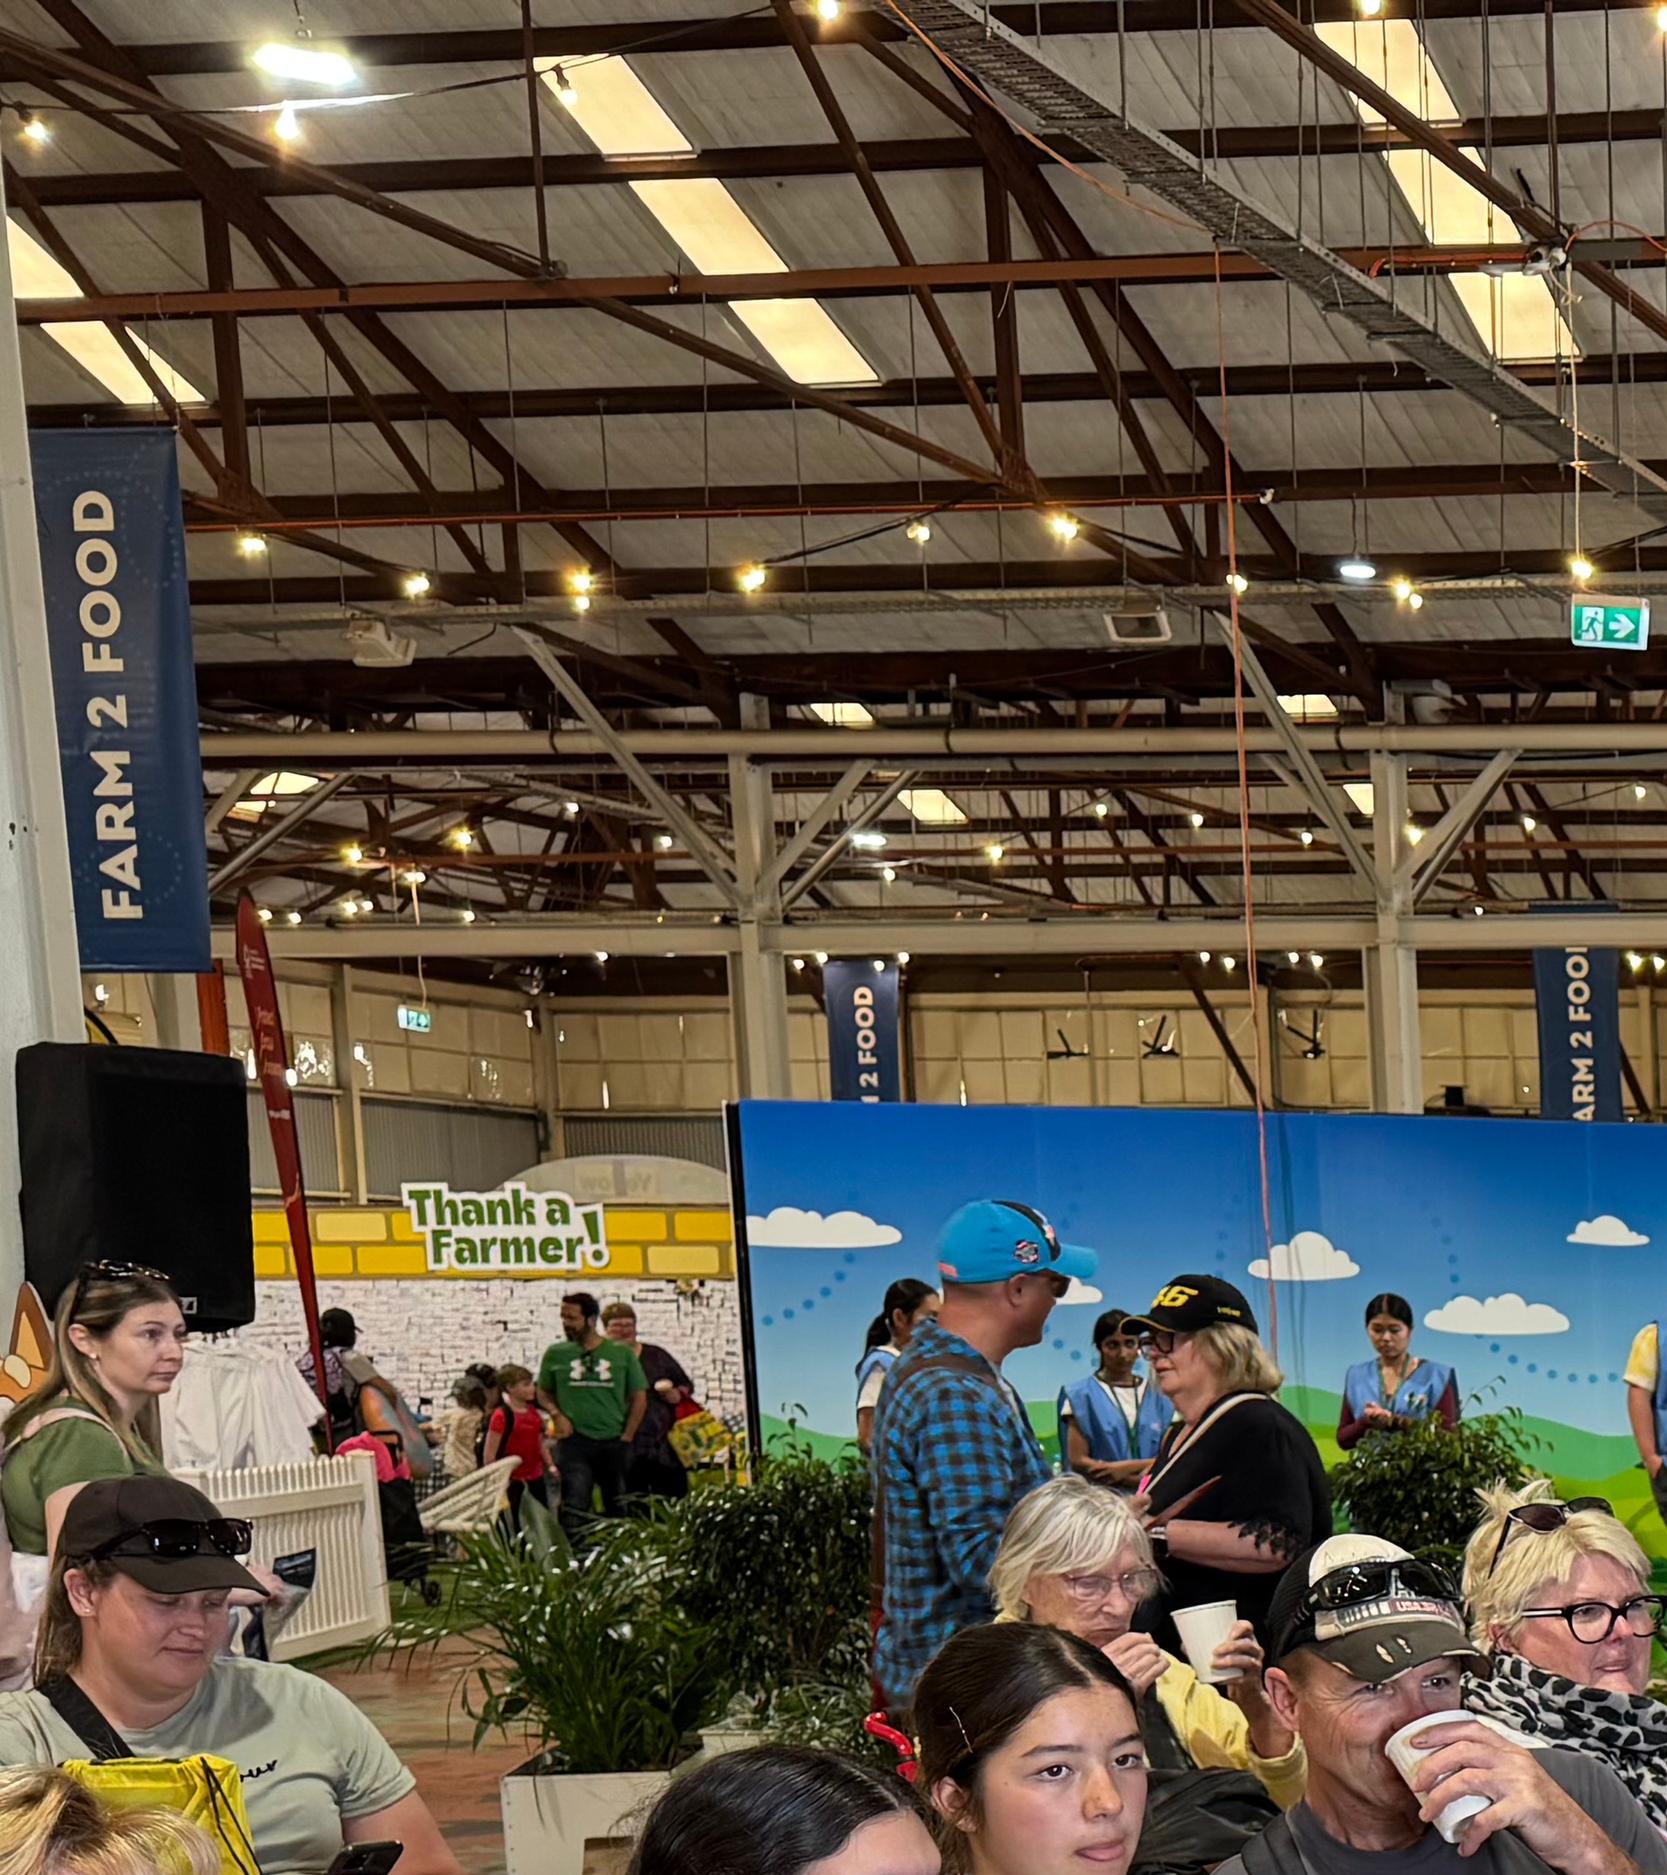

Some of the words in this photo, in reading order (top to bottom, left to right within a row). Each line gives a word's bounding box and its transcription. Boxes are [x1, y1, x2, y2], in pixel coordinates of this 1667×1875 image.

[73, 490, 125, 672] FOOD
[86, 694, 128, 728] 2
[90, 751, 143, 919] FARM
[1566, 947, 1592, 1021] FOO
[854, 986, 877, 1064] FOOD
[1570, 1031, 1593, 1048] 2
[859, 1072, 879, 1087] 2
[1572, 1058, 1596, 1121] ARM
[408, 1188, 536, 1226] Thank
[545, 1198, 571, 1226] a
[432, 1211, 604, 1265] Farmer!
